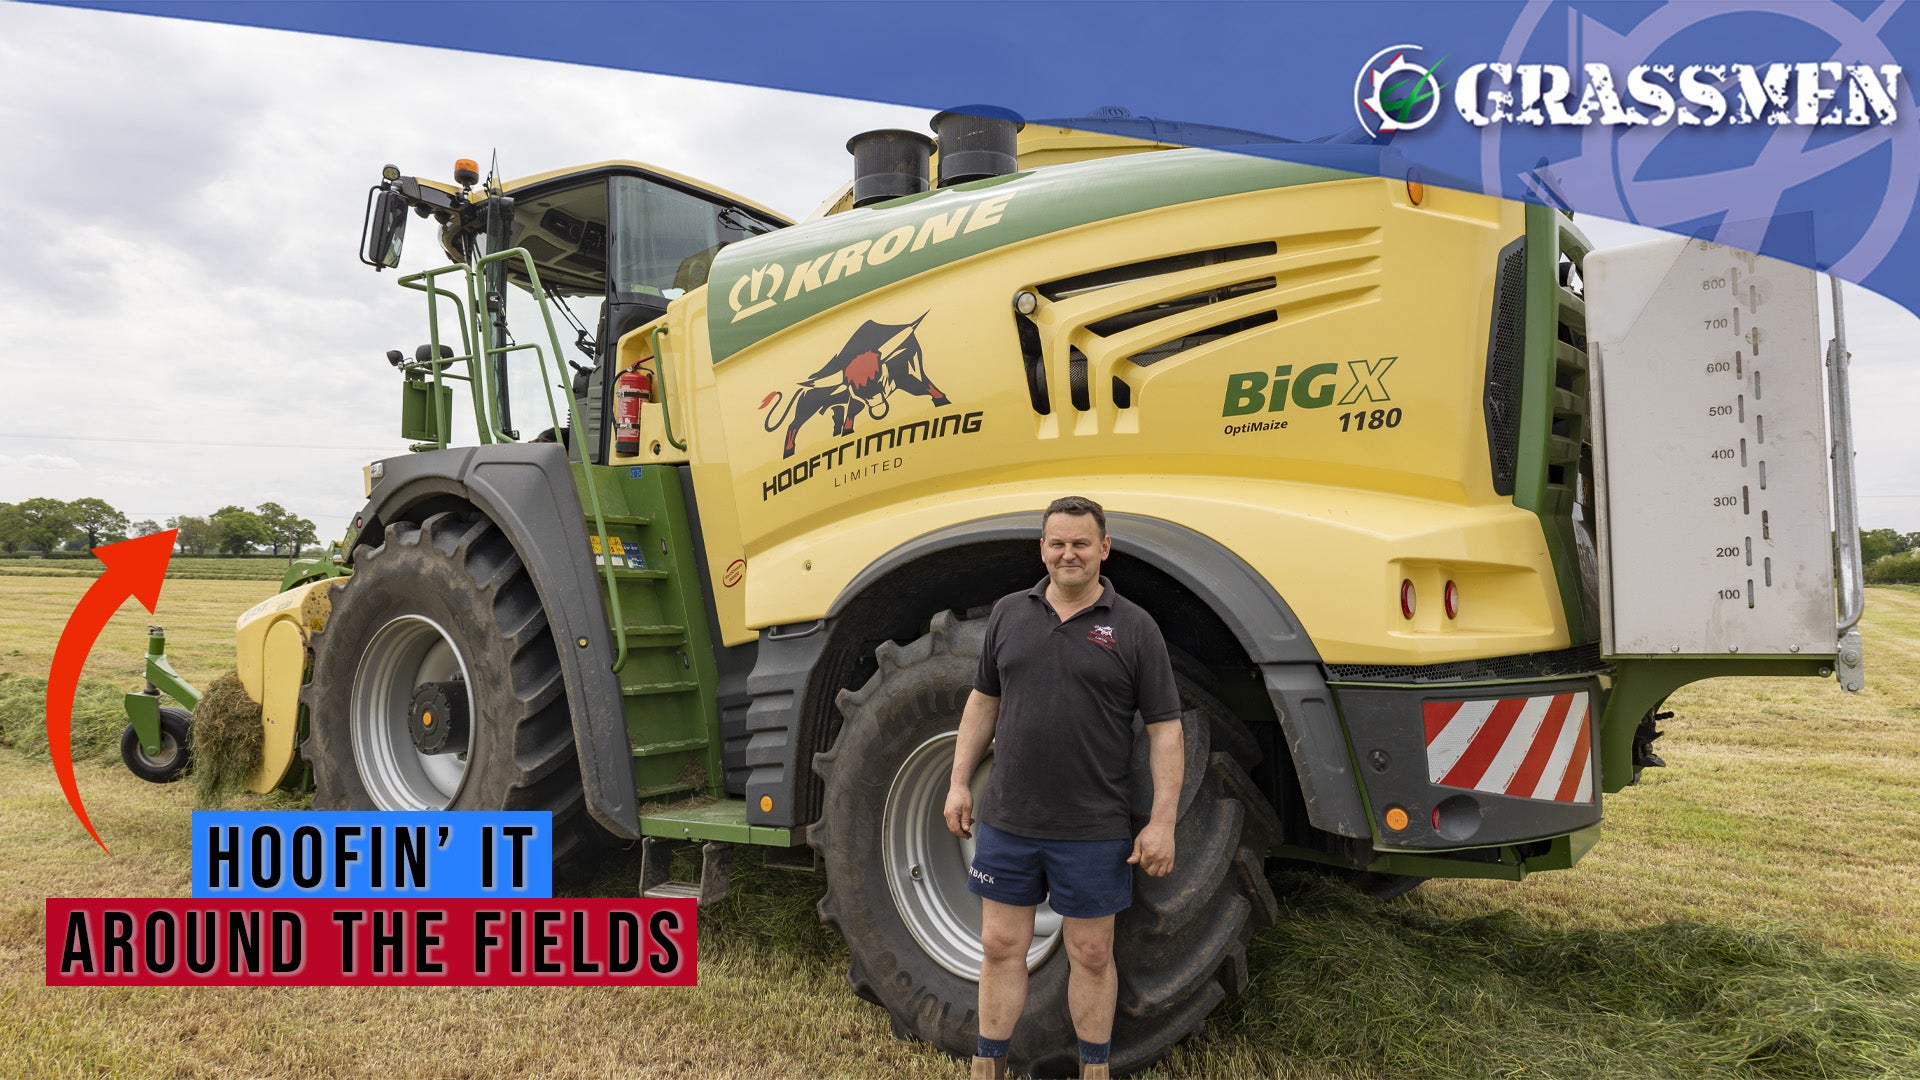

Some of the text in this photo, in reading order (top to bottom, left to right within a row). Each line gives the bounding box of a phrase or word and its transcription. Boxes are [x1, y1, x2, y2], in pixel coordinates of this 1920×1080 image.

[783, 192, 1016, 301] KRONE
[1702, 278, 1726, 291] 800
[1704, 318, 1728, 330] 700
[1706, 361, 1730, 374] 600
[1708, 405, 1732, 417] 500
[1338, 407, 1402, 433] 1180
[1224, 419, 1288, 436] OptiMaize
[762, 411, 983, 502] HOOFTRIMMING
[1711, 448, 1735, 460] 400
[834, 457, 903, 488] LIMITED
[1713, 495, 1737, 507] 300
[1715, 546, 1740, 558] 200
[1717, 589, 1741, 600] 100
